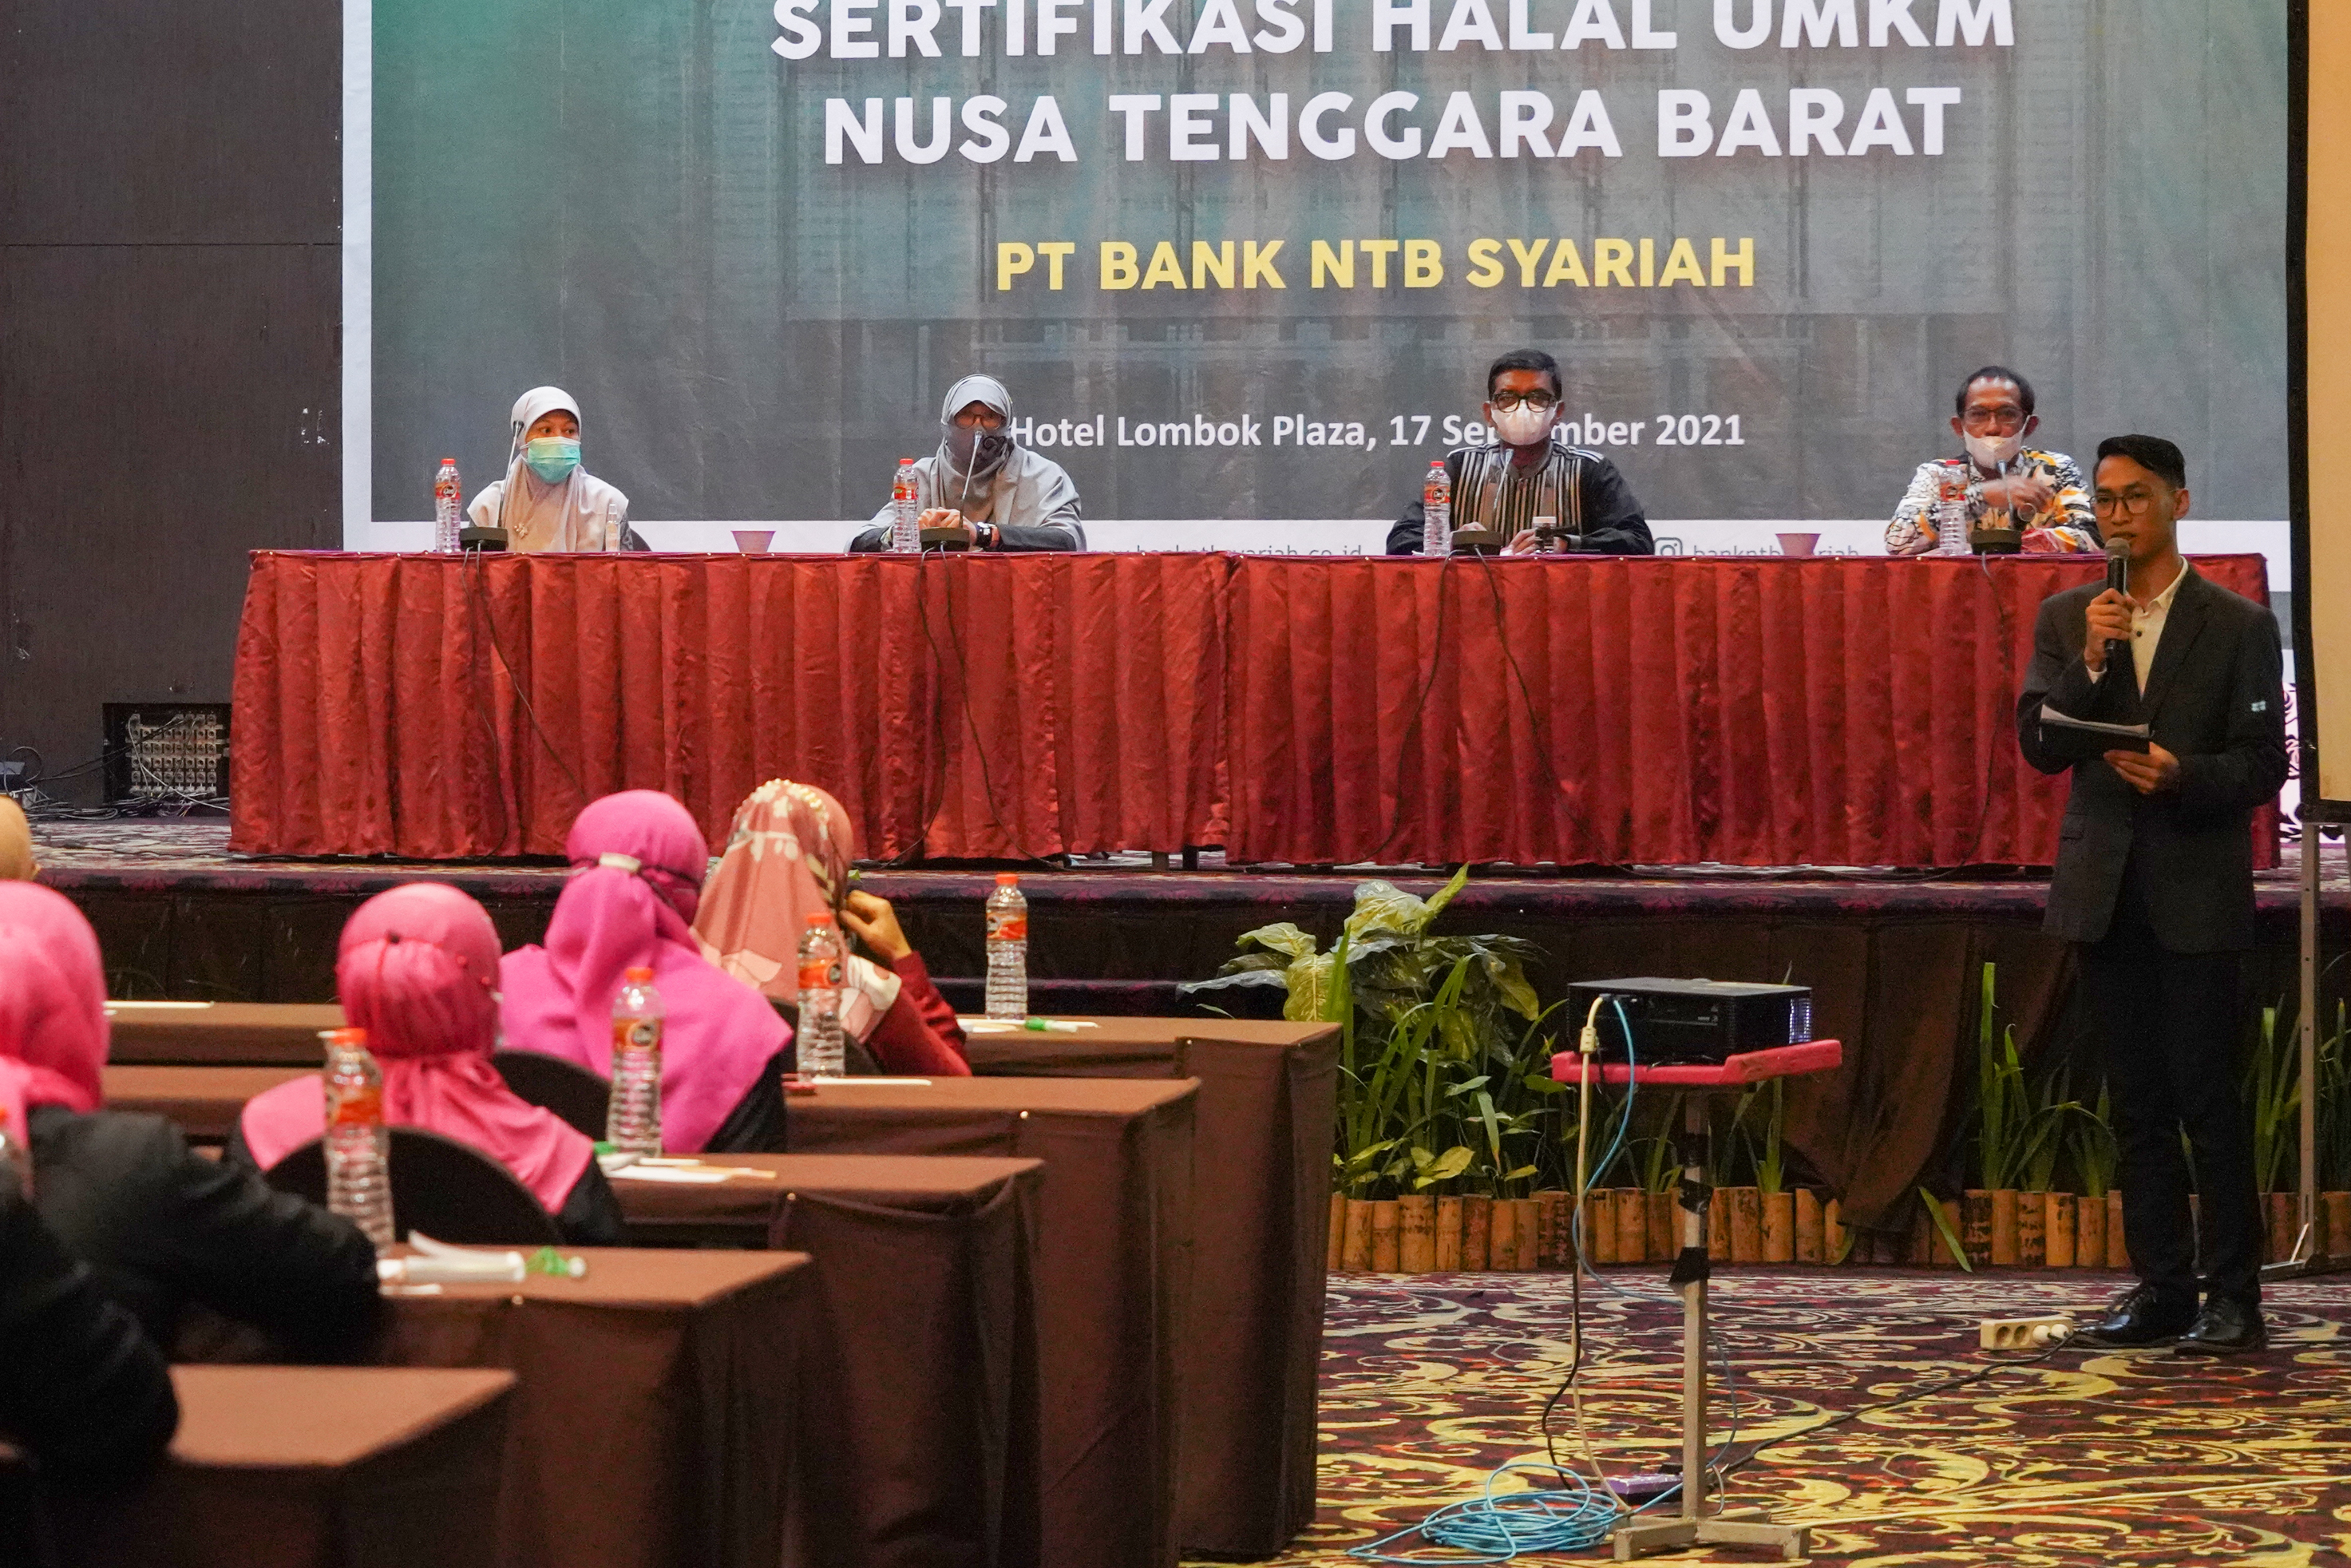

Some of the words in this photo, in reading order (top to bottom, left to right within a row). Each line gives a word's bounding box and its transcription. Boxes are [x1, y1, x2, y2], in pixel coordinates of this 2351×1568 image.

[771, 0, 1334, 60] SERTIFIKASI
[1372, 0, 1678, 52] HALAL
[1713, 0, 2015, 49] UMKM
[825, 94, 1079, 164] NUSA
[1108, 89, 1623, 161] TENGGARA
[1658, 87, 1961, 157] BARAT
[997, 242, 1075, 291] PT
[1100, 240, 1285, 291] BANK
[1311, 239, 1444, 289] NTB
[1466, 237, 1755, 288] SYARIAH
[1011, 414, 1104, 447] Hotel
[1118, 414, 1261, 446] Lombok
[1273, 414, 1376, 452] Plaza,
[1390, 415, 1431, 445] 17
[1442, 413, 1646, 446] Sember
[1656, 414, 1745, 445] 2021
